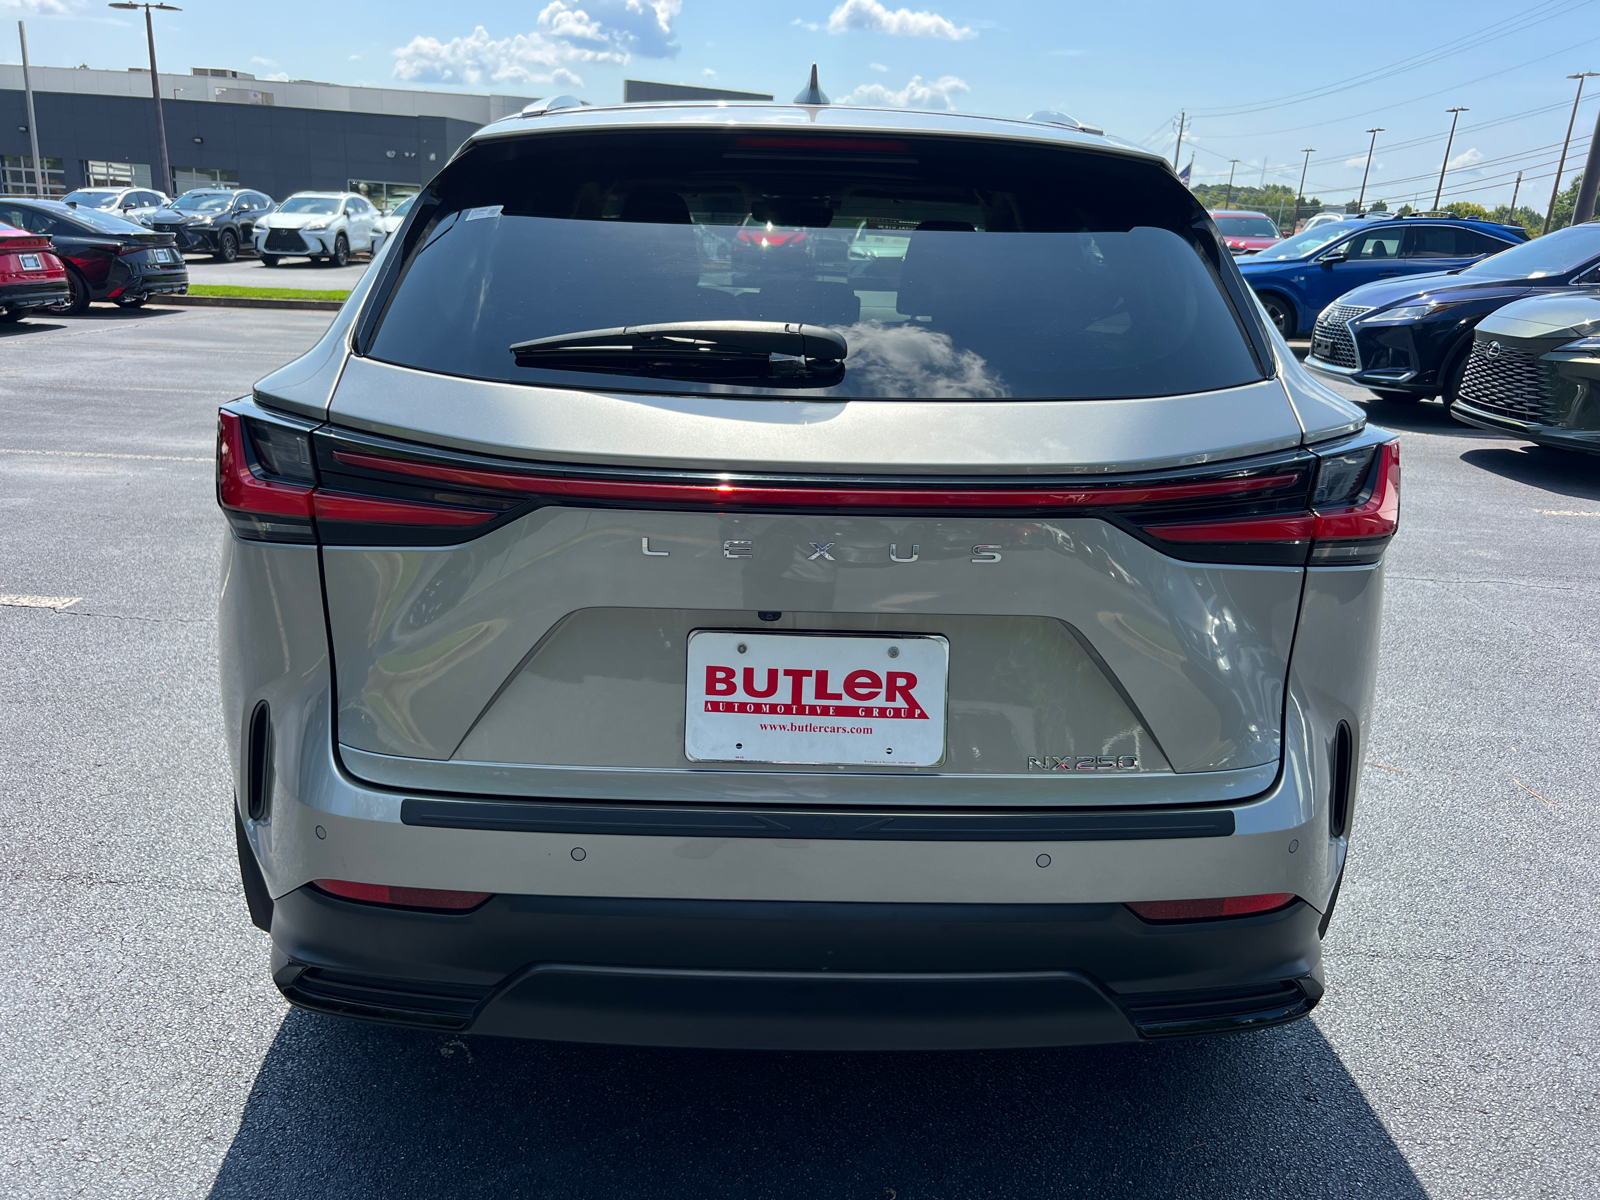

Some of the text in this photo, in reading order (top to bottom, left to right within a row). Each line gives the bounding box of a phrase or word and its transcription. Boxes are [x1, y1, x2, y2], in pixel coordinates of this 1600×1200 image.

[642, 537, 1002, 563] LEXUS
[705, 702, 921, 718] AUTOMOTIVE GROUP
[759, 722, 873, 735] www.butlercars.com
